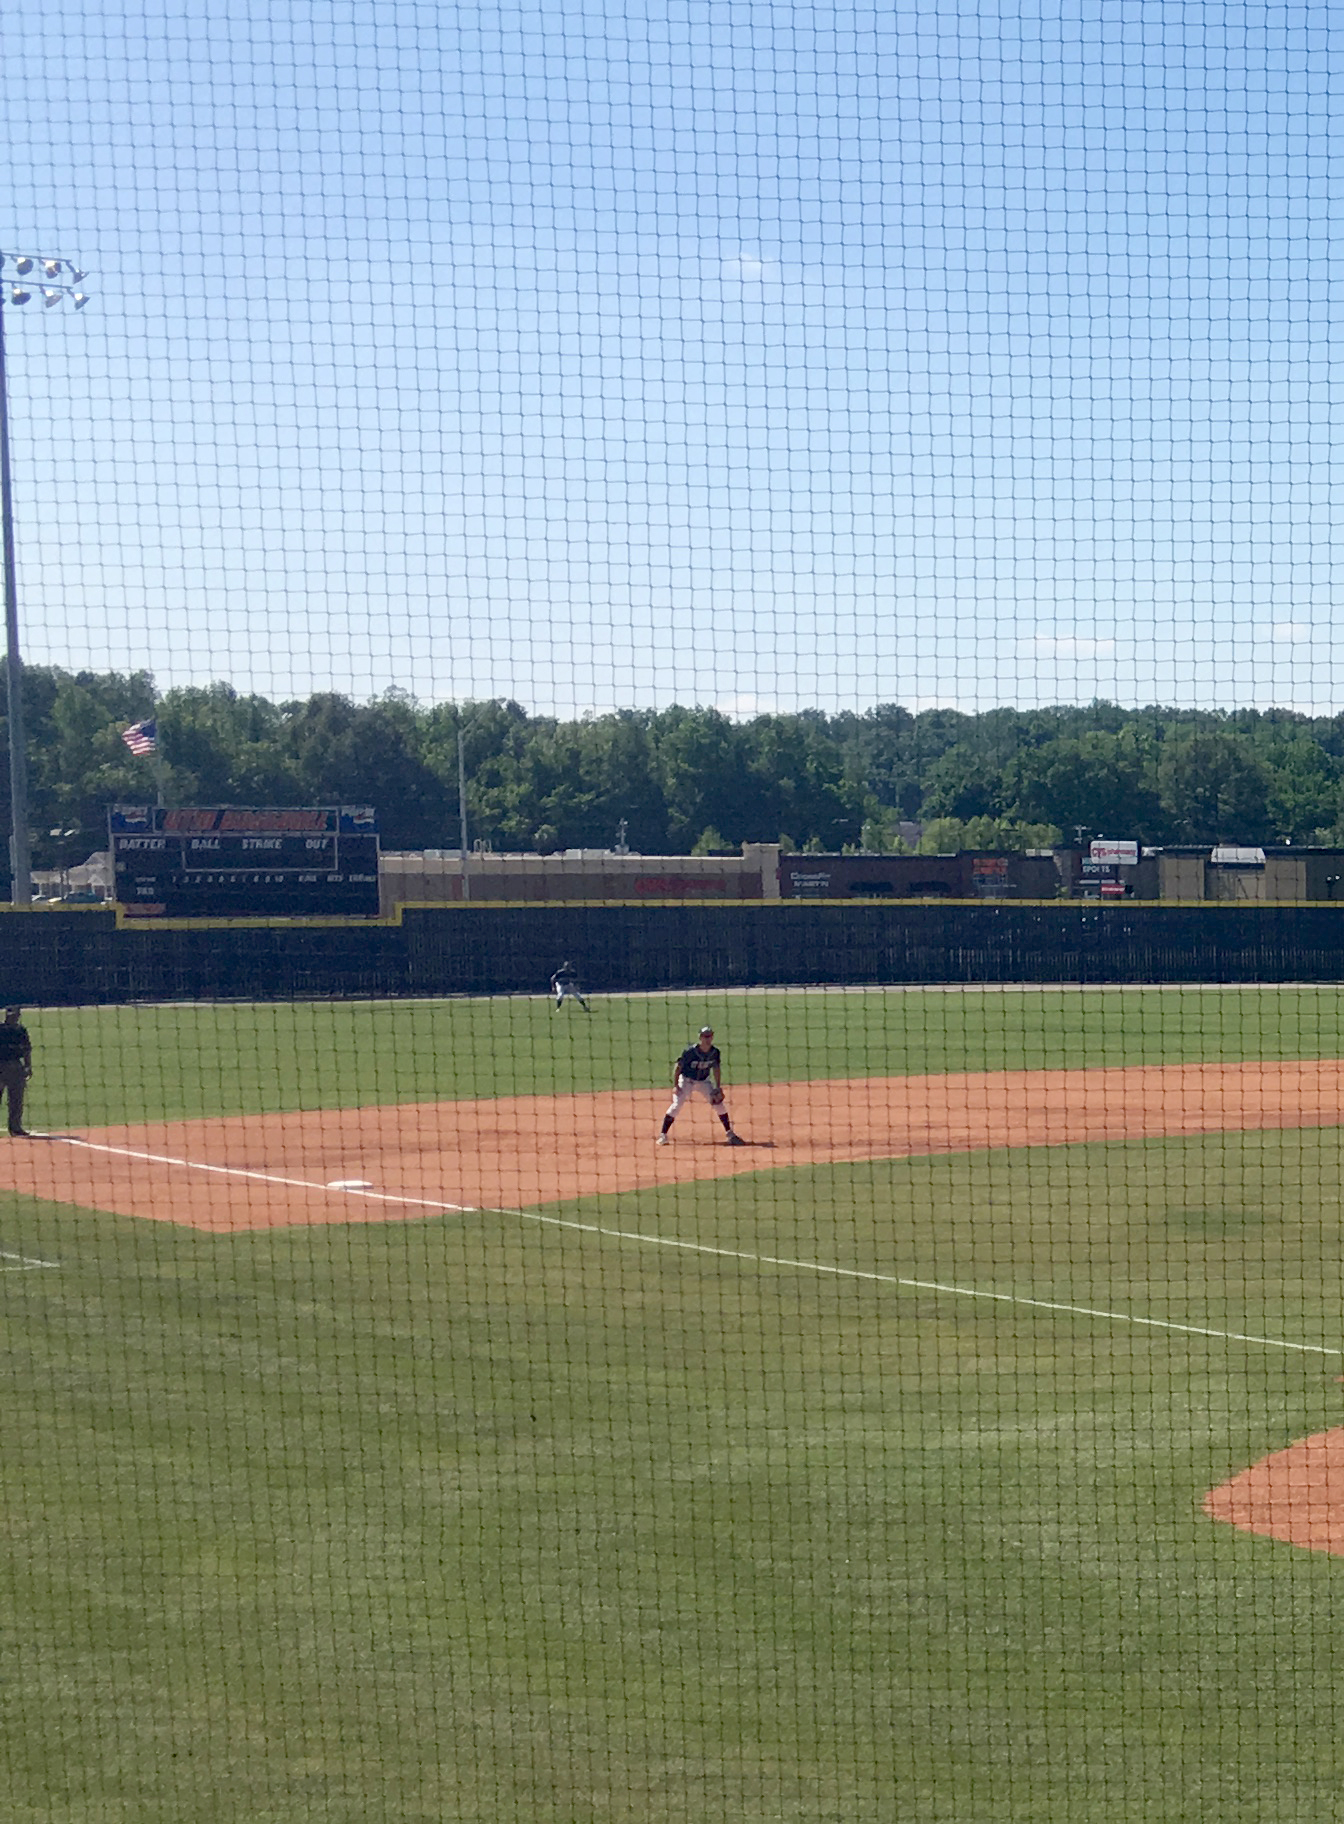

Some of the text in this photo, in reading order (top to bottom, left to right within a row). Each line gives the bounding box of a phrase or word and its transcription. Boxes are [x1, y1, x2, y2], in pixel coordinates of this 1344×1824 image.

[119, 838, 166, 850] BATTER
[191, 838, 220, 850] BALL
[242, 838, 283, 850] STRIKE
[305, 838, 328, 850] OUT
